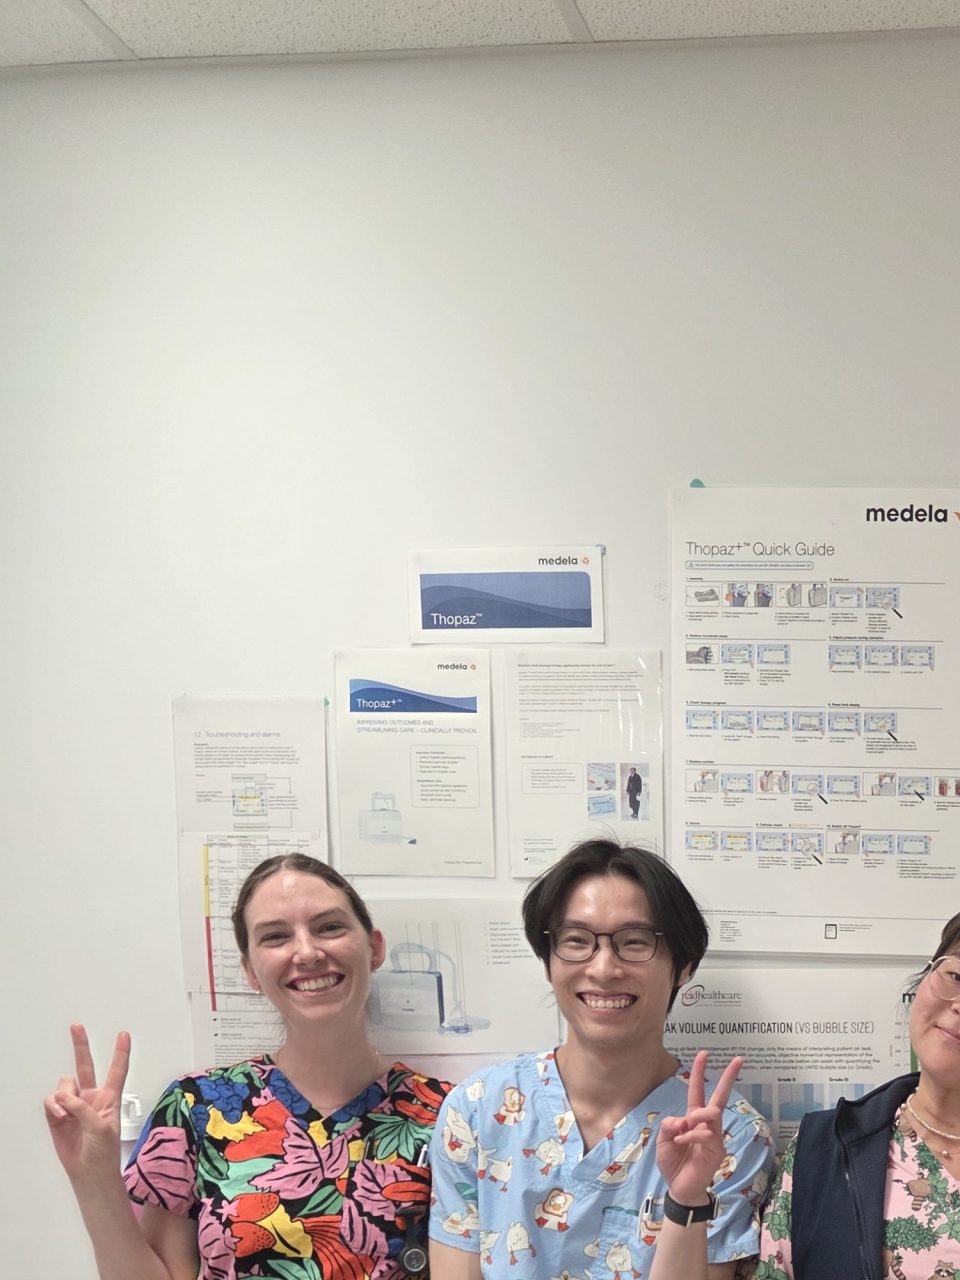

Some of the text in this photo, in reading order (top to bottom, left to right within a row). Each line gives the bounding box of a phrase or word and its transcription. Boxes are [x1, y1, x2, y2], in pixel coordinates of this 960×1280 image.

[867, 504, 948, 523] medela
[753, 542, 791, 556] Quick
[795, 541, 835, 556] Guide
[538, 556, 578, 565] medela
[665, 1021, 874, 1035] AK VOLUME QUANTIFICATION (VS BUBBLE SIZE)
